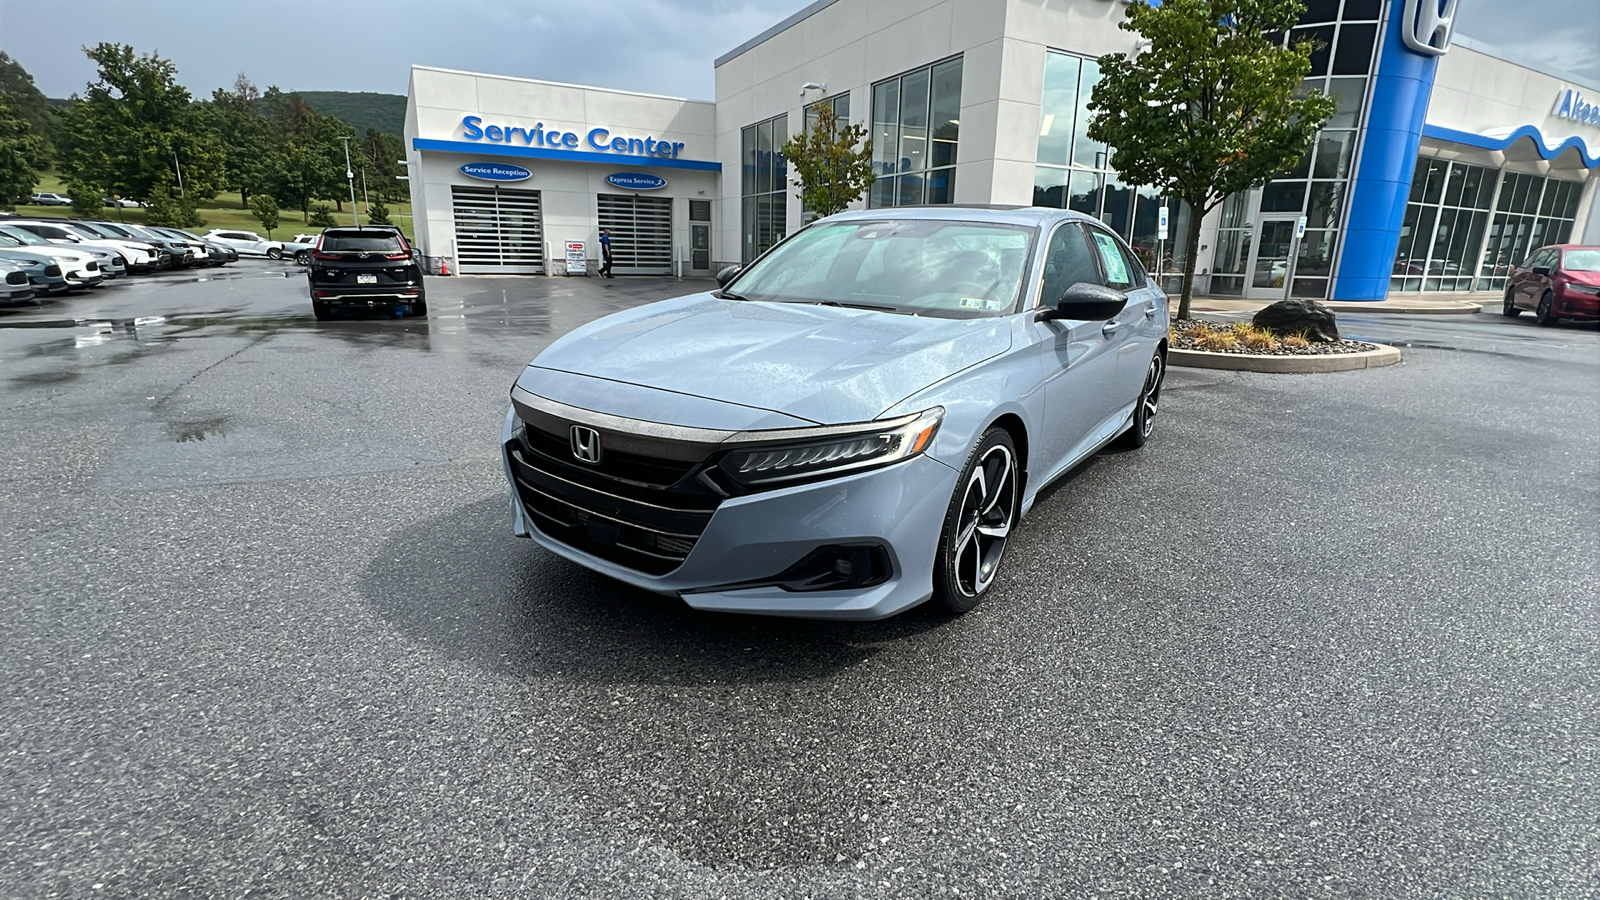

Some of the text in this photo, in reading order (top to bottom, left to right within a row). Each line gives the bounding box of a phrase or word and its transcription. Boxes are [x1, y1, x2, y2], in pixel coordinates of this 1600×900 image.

[462, 115, 685, 158] Service Center
[464, 165, 528, 177] Service Reception
[609, 176, 655, 186] Express Service
